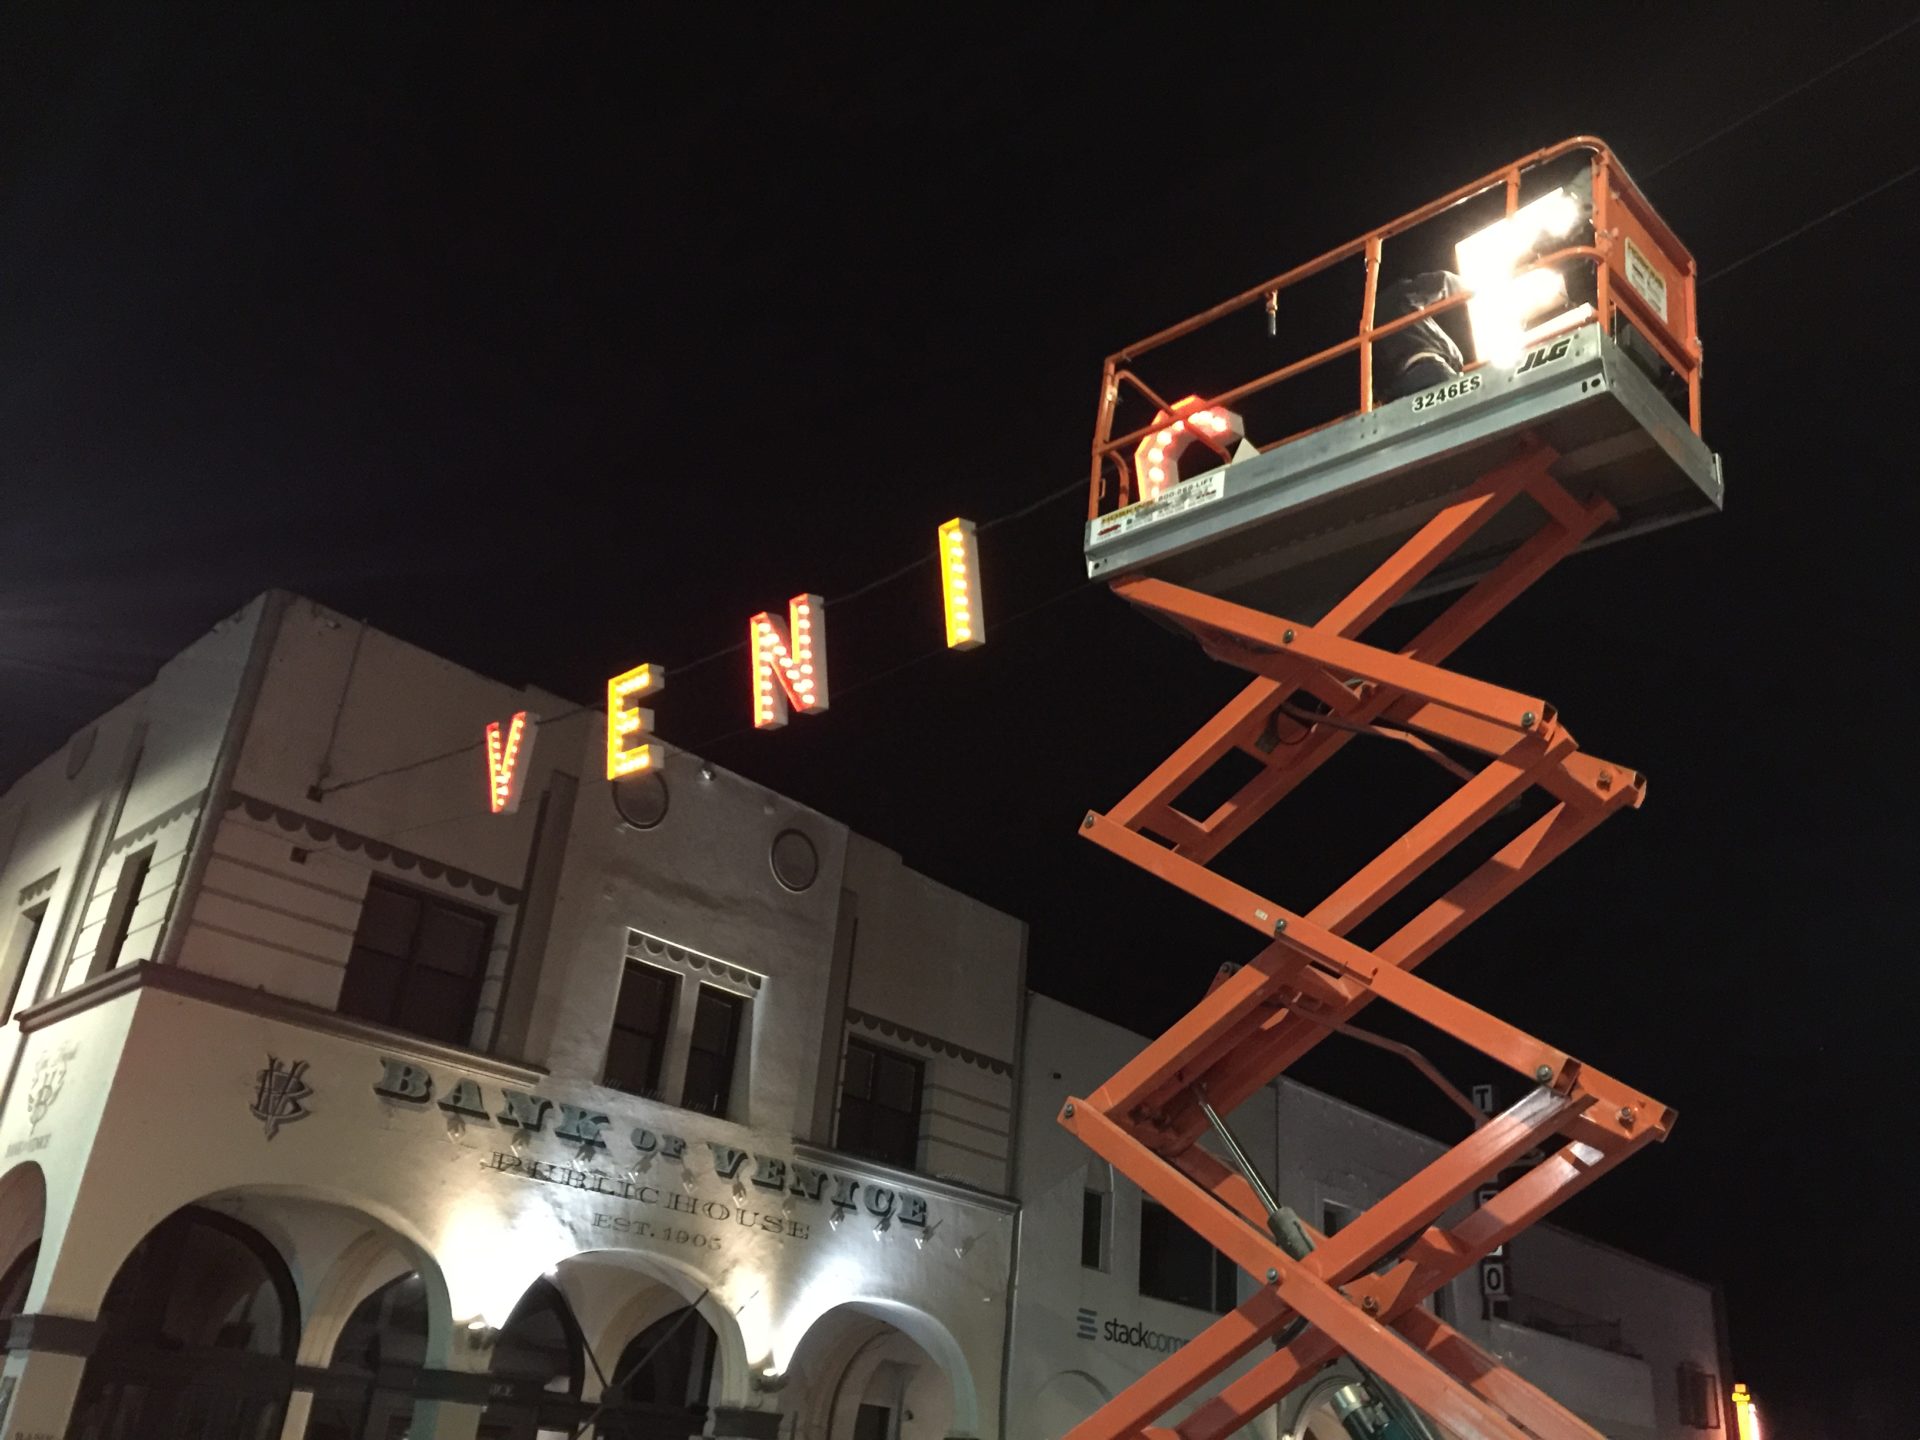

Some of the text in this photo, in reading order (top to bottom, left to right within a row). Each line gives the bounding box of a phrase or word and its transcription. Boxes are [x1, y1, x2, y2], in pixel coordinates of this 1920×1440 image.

[1516, 338, 1571, 375] JLG
[1413, 375, 1481, 412] 3246ES
[373, 1055, 611, 1150] BANK
[630, 1127, 687, 1160] OF
[706, 1141, 927, 1227] VENICE
[488, 1151, 811, 1241] PUBLIC HOUSE
[592, 1212, 723, 1252] EST. 1905
